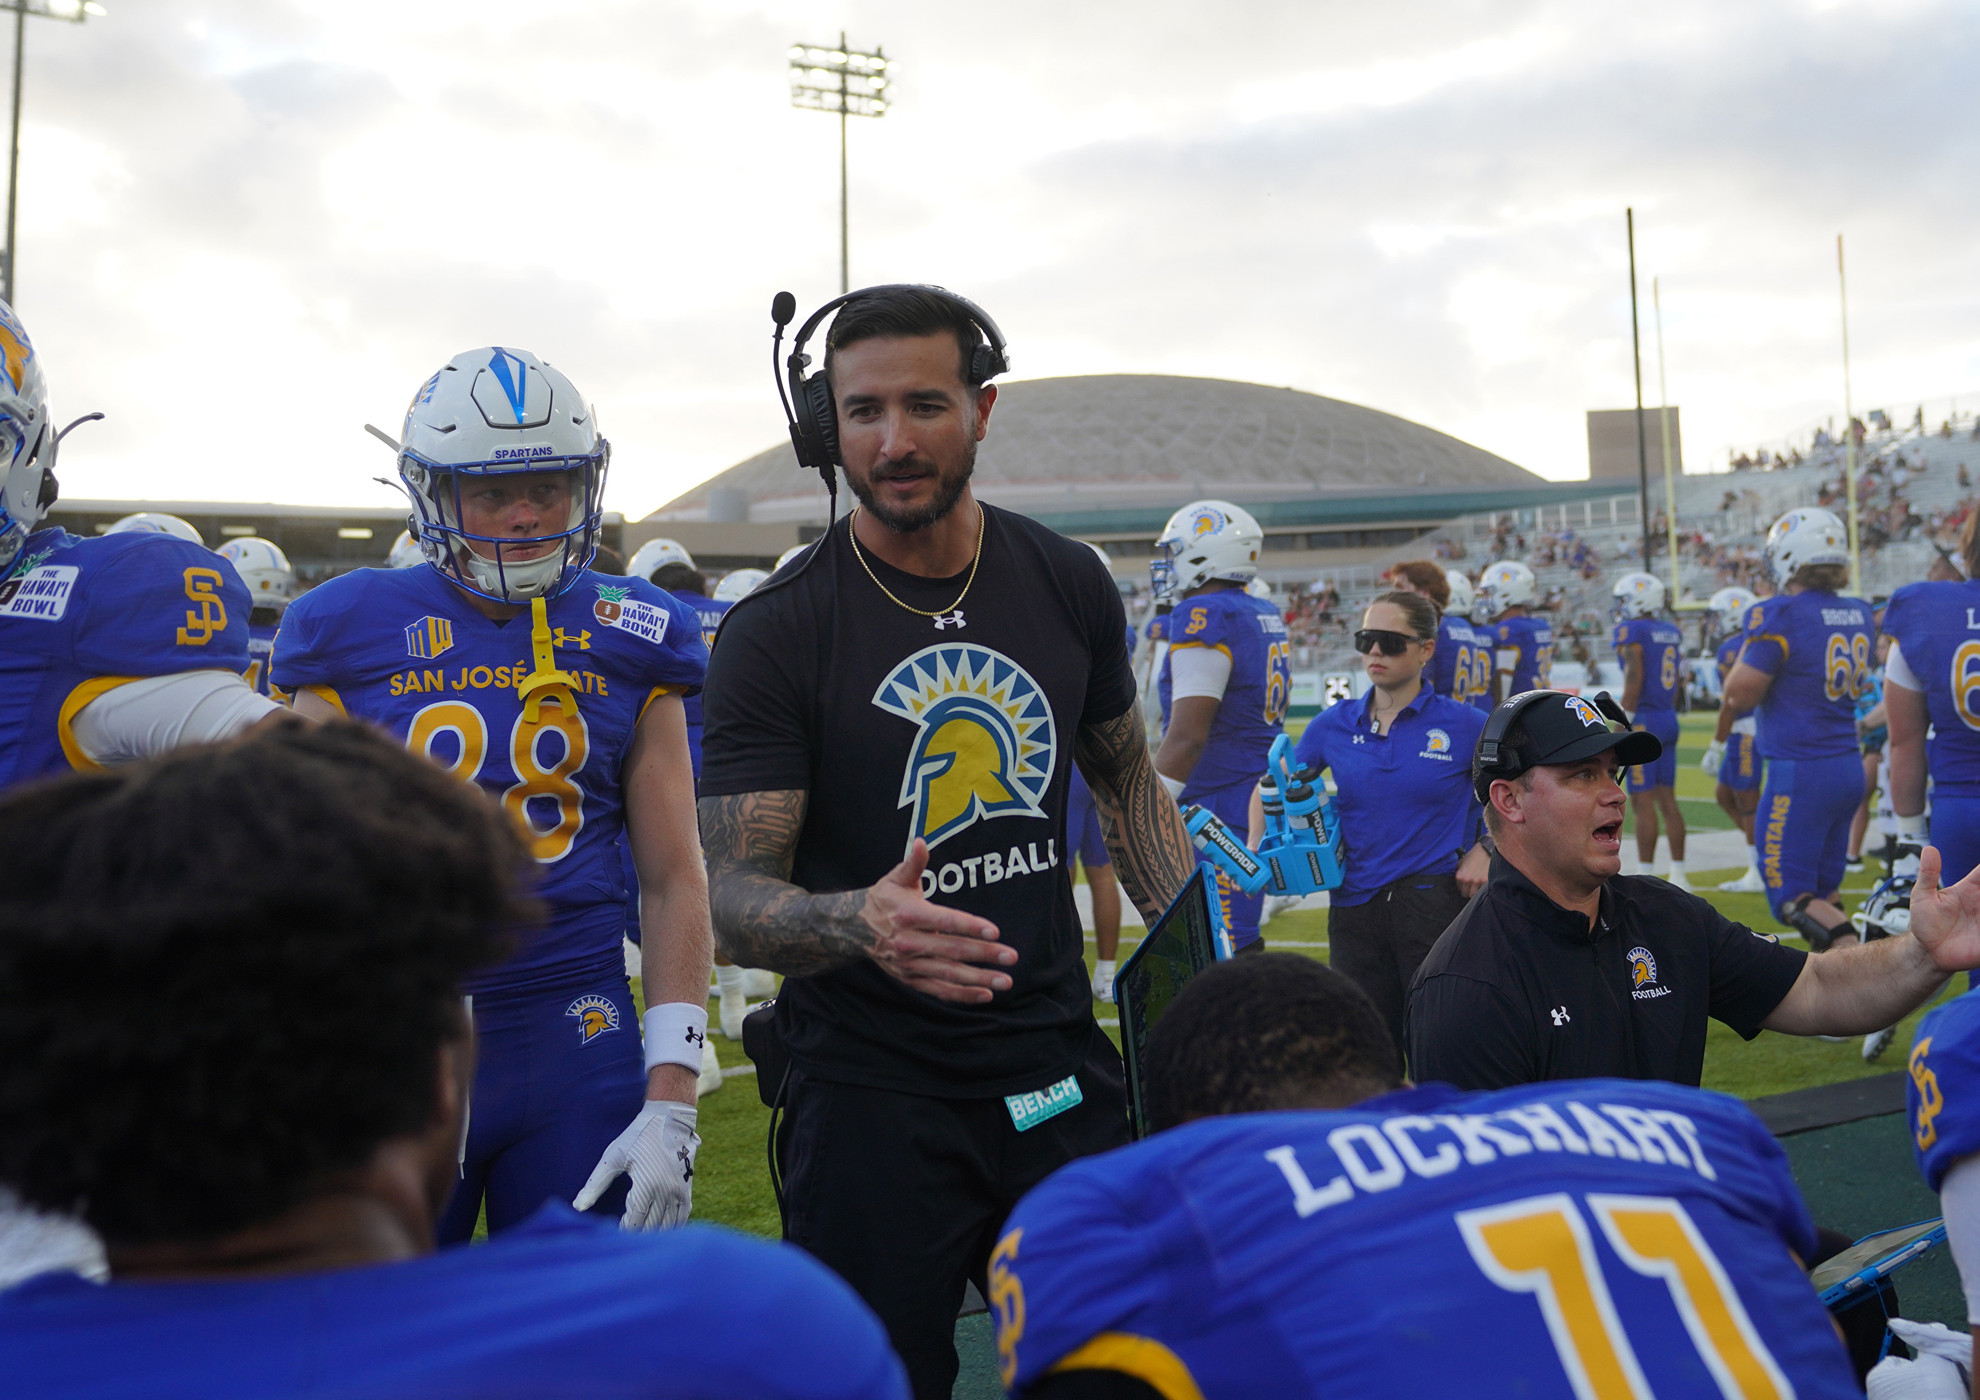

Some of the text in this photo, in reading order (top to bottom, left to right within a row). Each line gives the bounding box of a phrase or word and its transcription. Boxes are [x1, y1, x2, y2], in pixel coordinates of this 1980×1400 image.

[495, 446, 553, 459] SPARTANS
[40, 569, 60, 578] THE
[11, 598, 57, 617] BOWL
[637, 603, 654, 613] THE
[621, 618, 659, 641] BOWL
[390, 669, 444, 697] SAN
[452, 660, 528, 690] JOSÉ
[1660, 645, 1677, 690] 6
[1825, 632, 1870, 702] 68
[1419, 751, 1453, 761] FOOTBALL
[1312, 810, 1328, 846] POWE
[1764, 794, 1791, 889] SPARTANS
[1203, 821, 1257, 875] POWERADE
[920, 838, 1058, 900] OOTBALL
[1631, 985, 1671, 1000] FOOTBALL
[1009, 1075, 1078, 1121] BENCH
[1264, 1101, 1717, 1218] LOCKHART
[1454, 1192, 1798, 1400] 11
